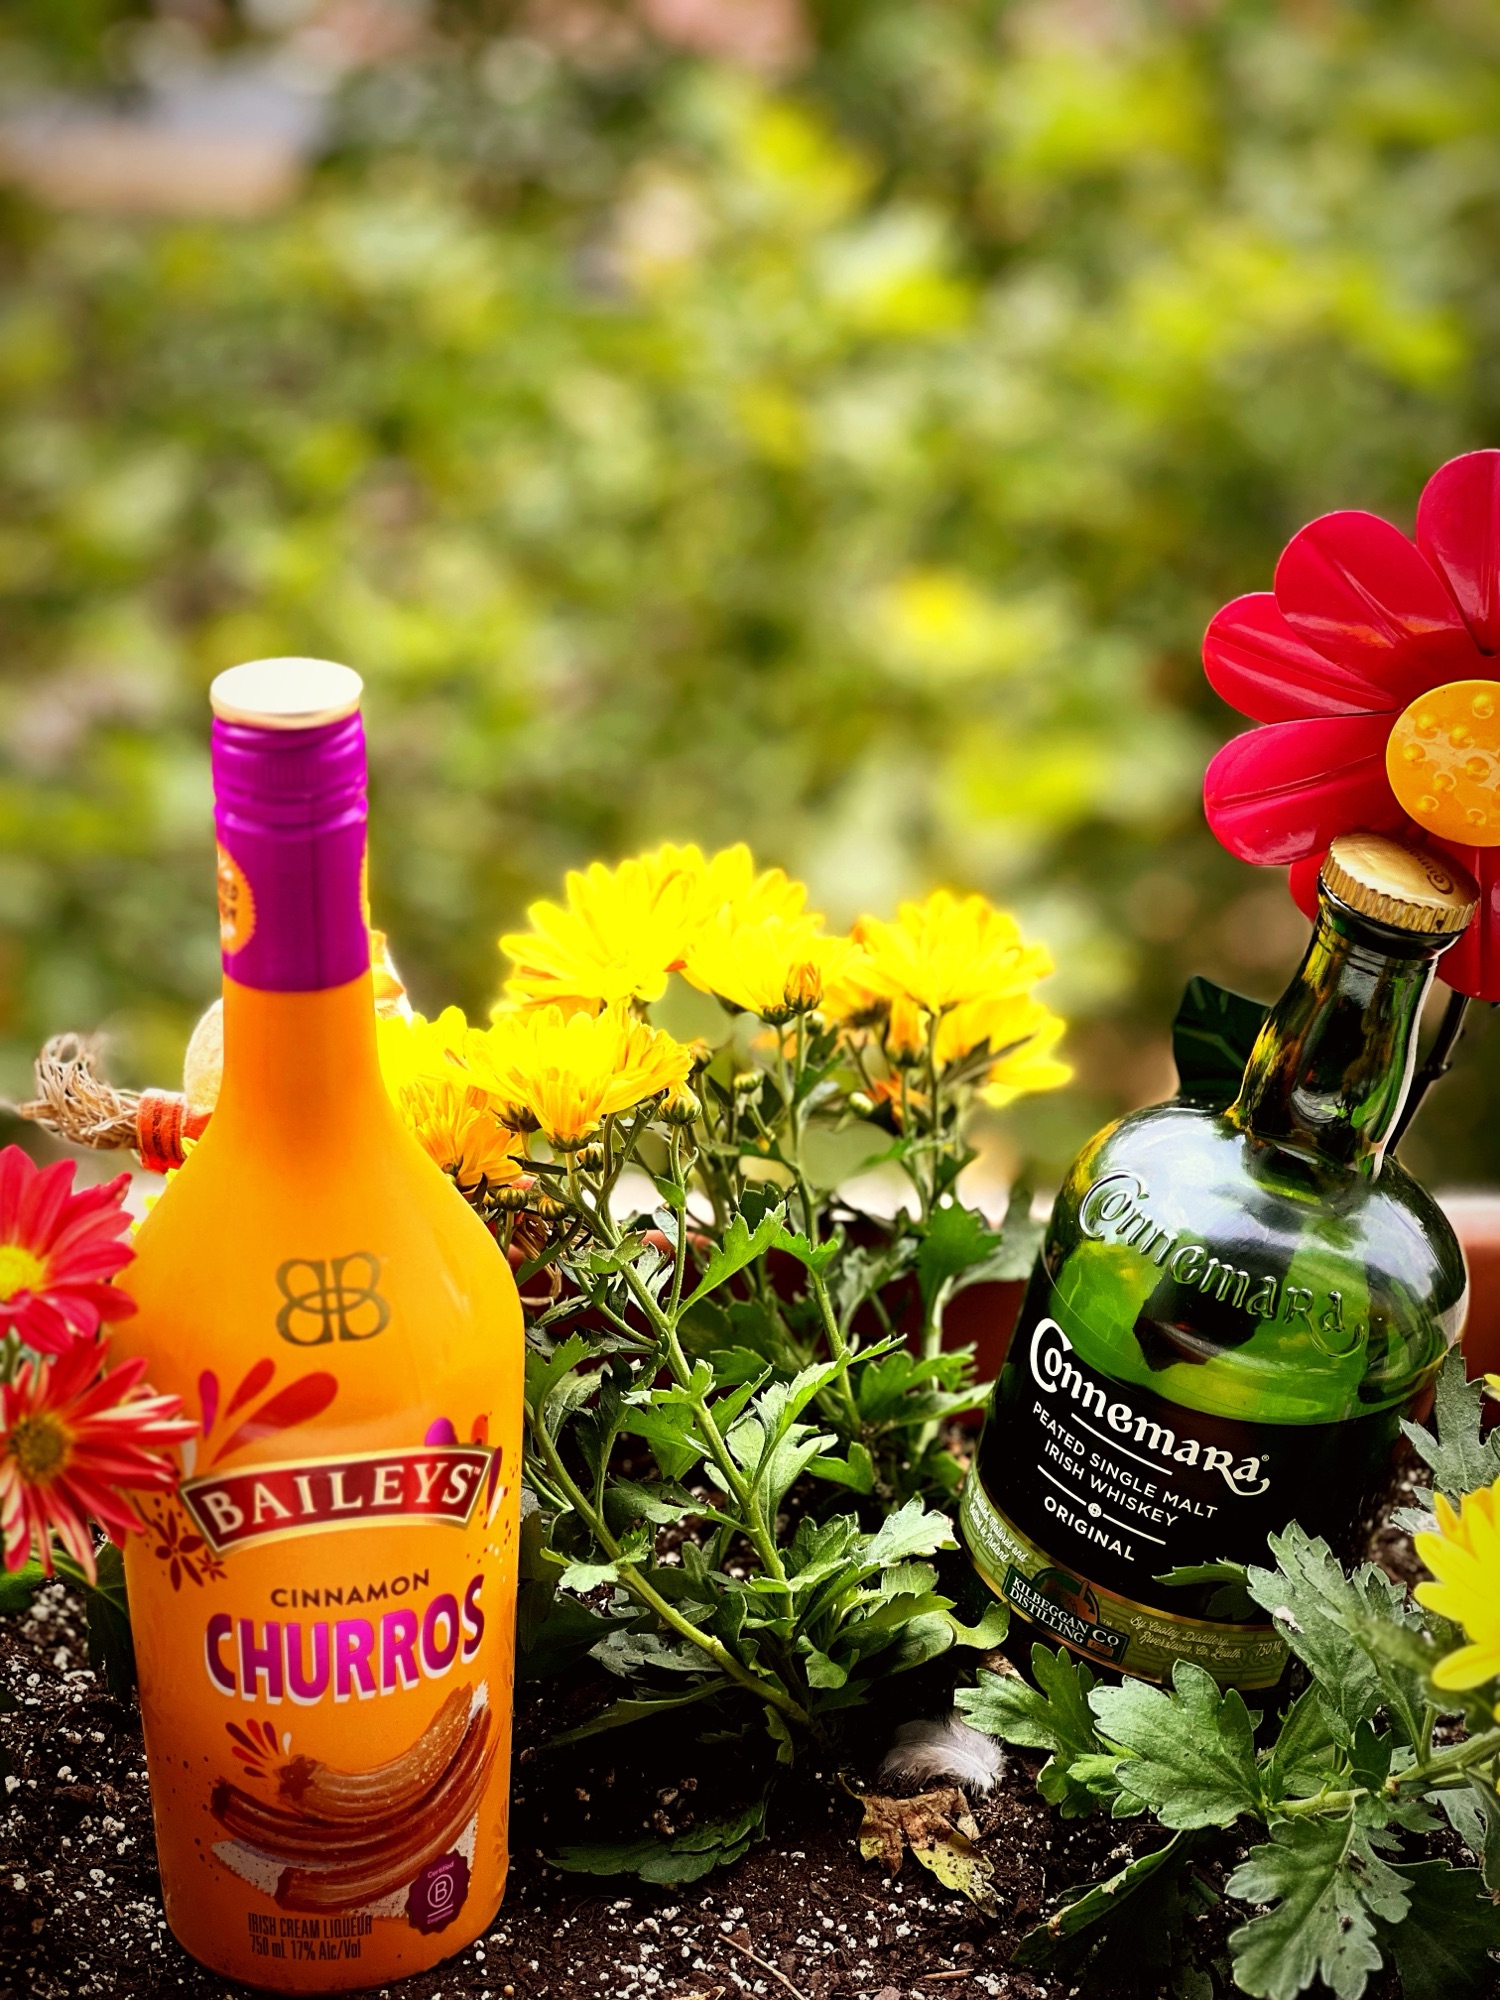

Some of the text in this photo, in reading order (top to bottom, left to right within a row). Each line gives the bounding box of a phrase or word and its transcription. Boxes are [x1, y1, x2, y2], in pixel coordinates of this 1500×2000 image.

[1079, 1169, 1365, 1359] Connemara
[1032, 1401, 1218, 1520] PEATED SINGLE MALT
[1044, 1439, 1179, 1528] IRISH WHISKEY
[201, 1461, 475, 1535] BAILEYS
[984, 1533, 1010, 1562] Ireland
[1012, 1546, 1029, 1562] and
[1044, 1496, 1135, 1562] ORIGINAL
[270, 1568, 430, 1608] CINNAMON
[1009, 1585, 1085, 1644] DISTILLING
[1012, 1575, 1089, 1634] KILBEGGAN
[205, 1573, 485, 1706] CHURROS
[1130, 1615, 1147, 1629] By
[1148, 1620, 1182, 1640] Cooley
[427, 1860, 455, 1879] Certified
[248, 1912, 373, 1939] IRISH CREAM LIQUEUR
[249, 1934, 361, 1960] 750 mL 17% Alc/Vol
